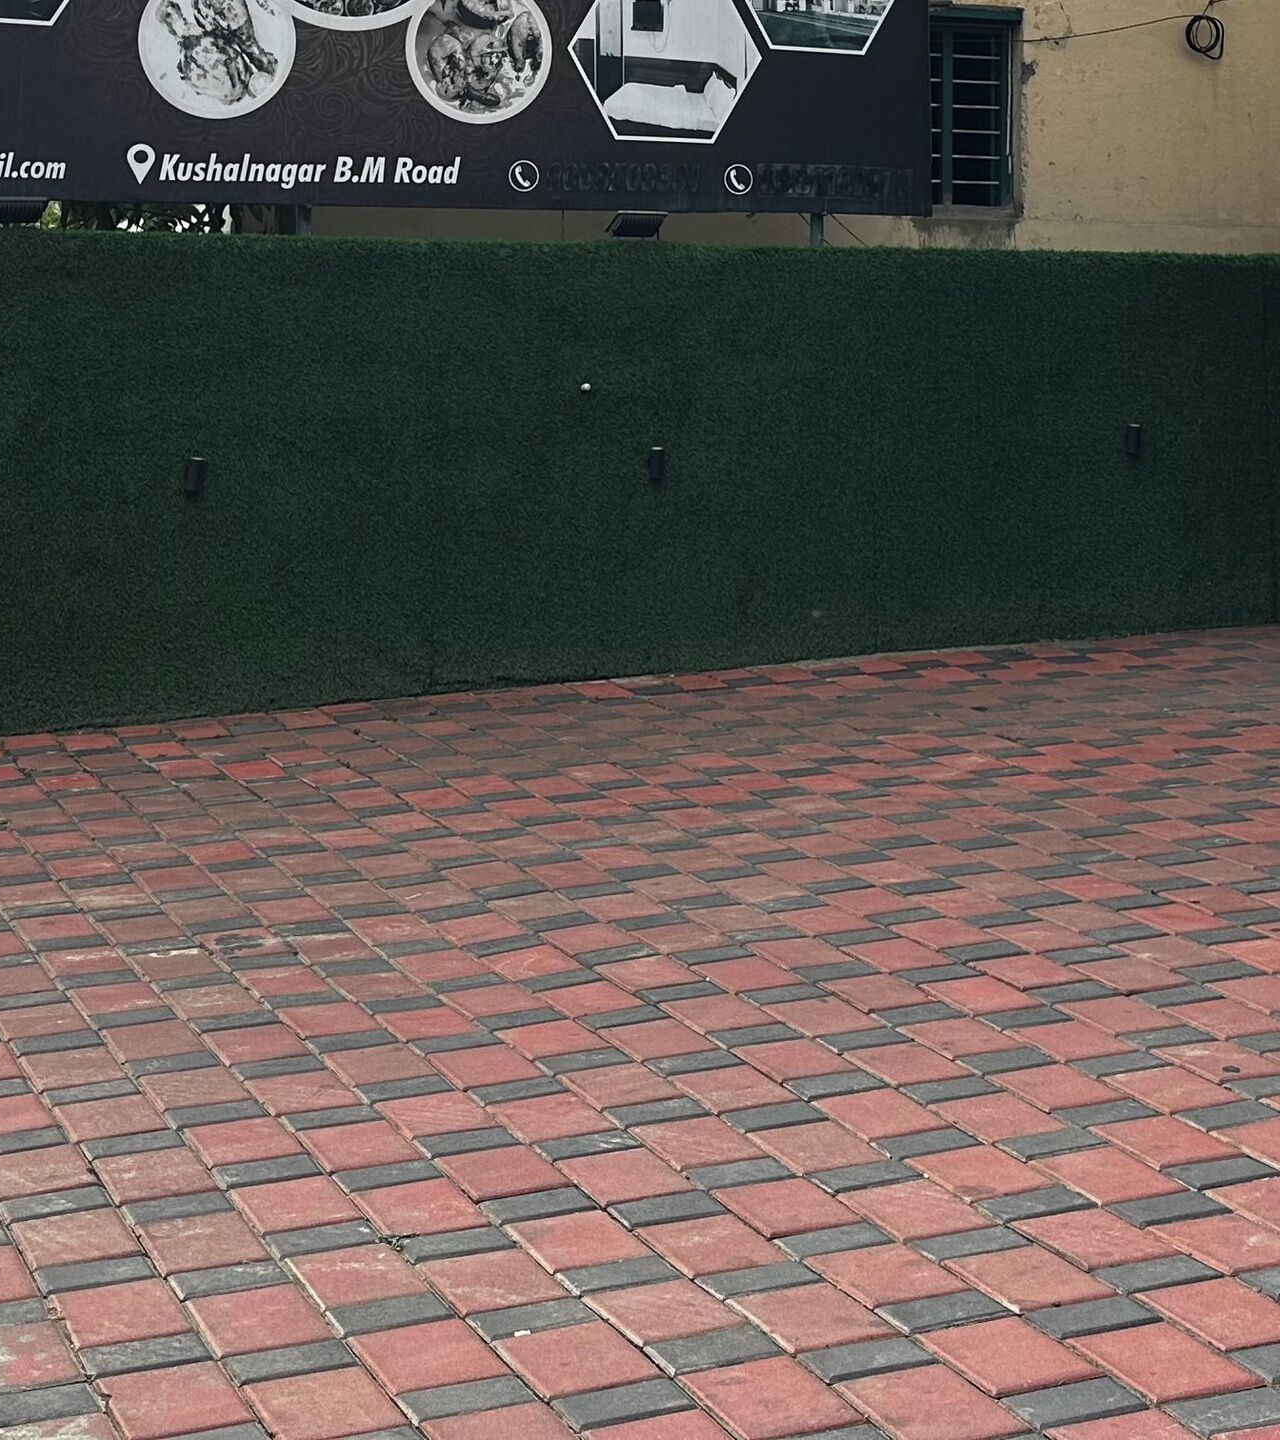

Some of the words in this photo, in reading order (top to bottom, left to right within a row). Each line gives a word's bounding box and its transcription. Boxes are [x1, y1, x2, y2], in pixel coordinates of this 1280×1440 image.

[159, 153, 326, 189] Kushalnagar
[333, 157, 386, 184] B.M
[394, 157, 461, 184] Road
